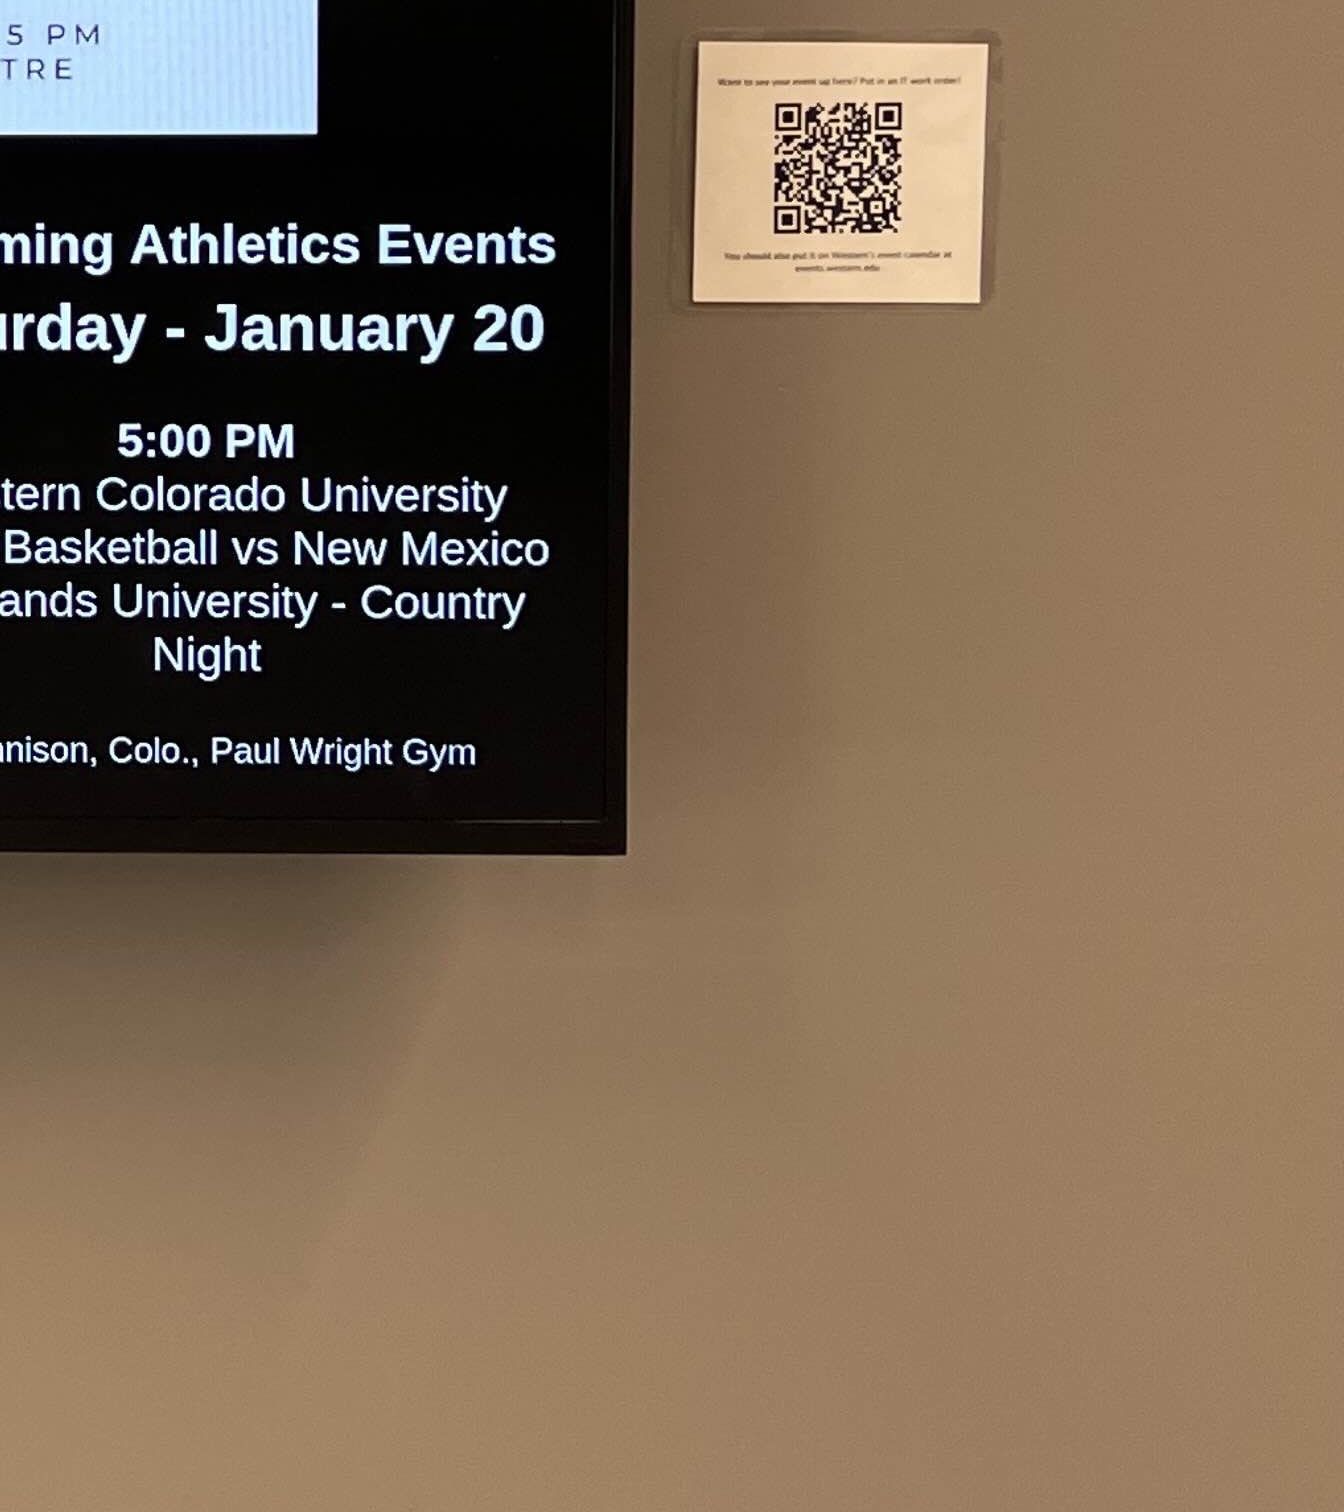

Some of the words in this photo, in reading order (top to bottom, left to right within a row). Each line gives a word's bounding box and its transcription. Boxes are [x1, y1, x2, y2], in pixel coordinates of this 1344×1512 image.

[7, 24, 23, 45] 5
[48, 24, 99, 45] PM
[131, 223, 360, 264] Athletics
[379, 224, 555, 264] Events
[205, 304, 454, 364] January
[474, 304, 544, 351] 20
[118, 423, 211, 457] 5:00
[227, 424, 293, 458] PM
[97, 476, 285, 511] Colorado
[302, 476, 508, 522] University
[5, 529, 216, 564] Basketball
[232, 538, 278, 565] vs
[295, 531, 387, 565] New
[403, 530, 549, 566] Mexico
[114, 582, 318, 628] University
[361, 585, 525, 629] Country
[155, 636, 261, 681] Night
[109, 736, 198, 767] Colo.,
[212, 737, 279, 764] Paul
[290, 737, 393, 772] Wright
[403, 738, 475, 772] Gym
